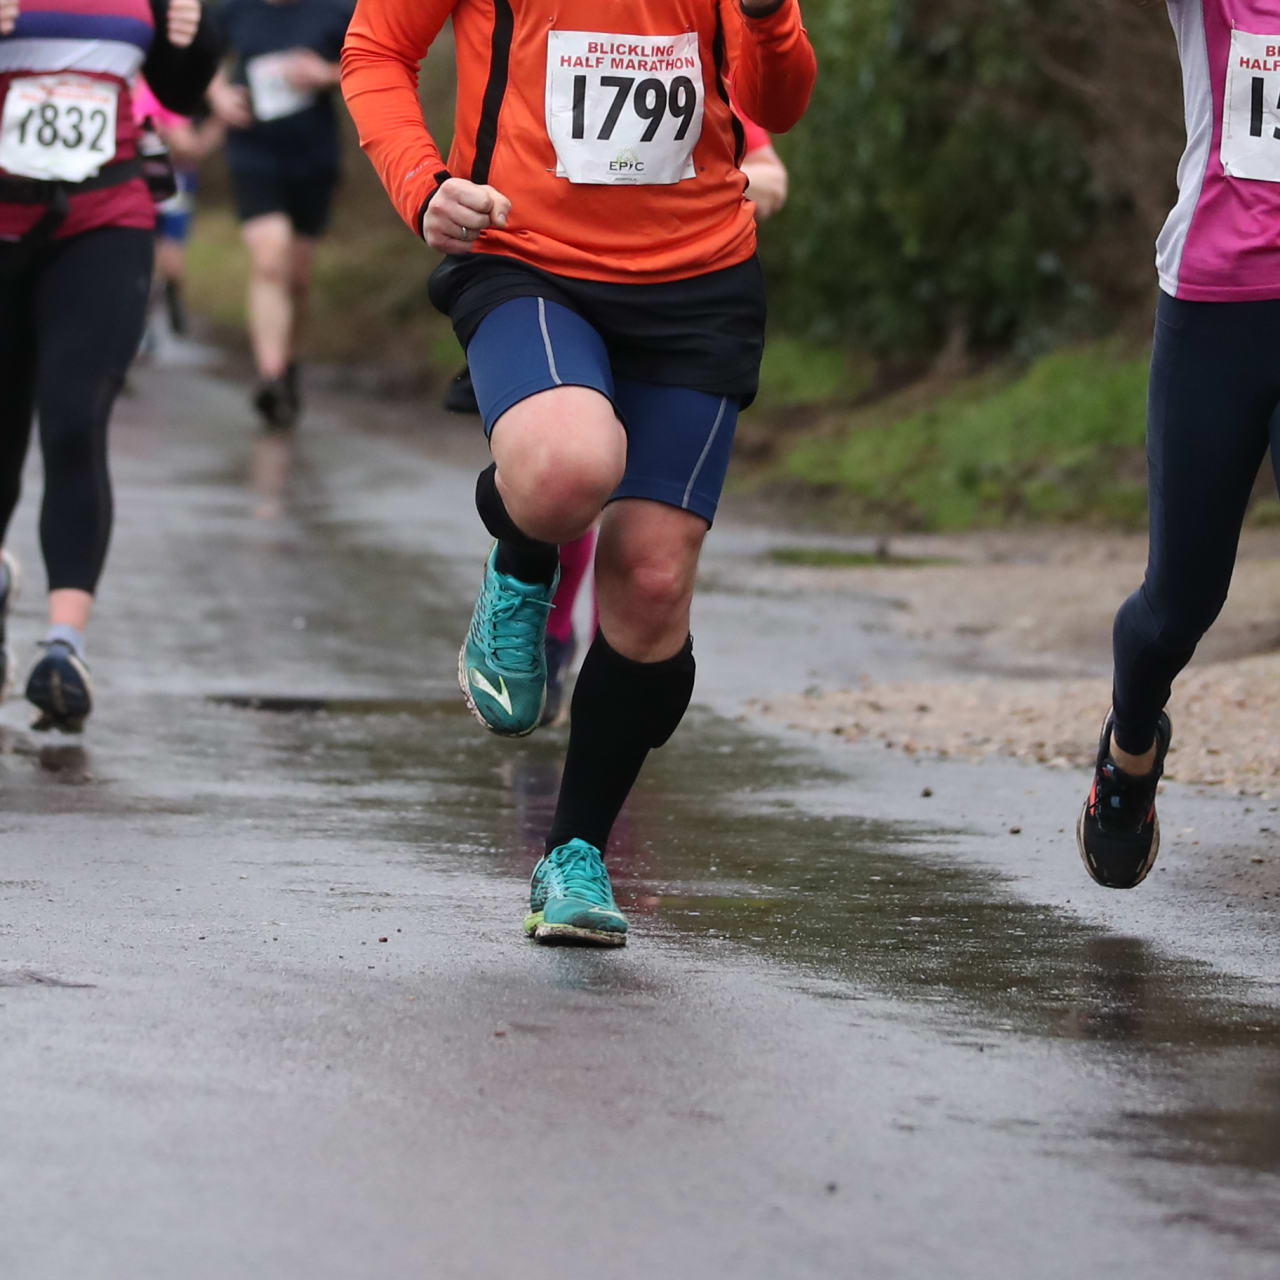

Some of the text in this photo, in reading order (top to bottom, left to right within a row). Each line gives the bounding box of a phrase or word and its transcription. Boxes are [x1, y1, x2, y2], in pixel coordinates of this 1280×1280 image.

[587, 41, 674, 57] BLICKLING
[560, 55, 695, 72] HALF MARATHON
[571, 75, 696, 142] 1799
[19, 102, 107, 152] 1832
[609, 161, 644, 171] EPIC
